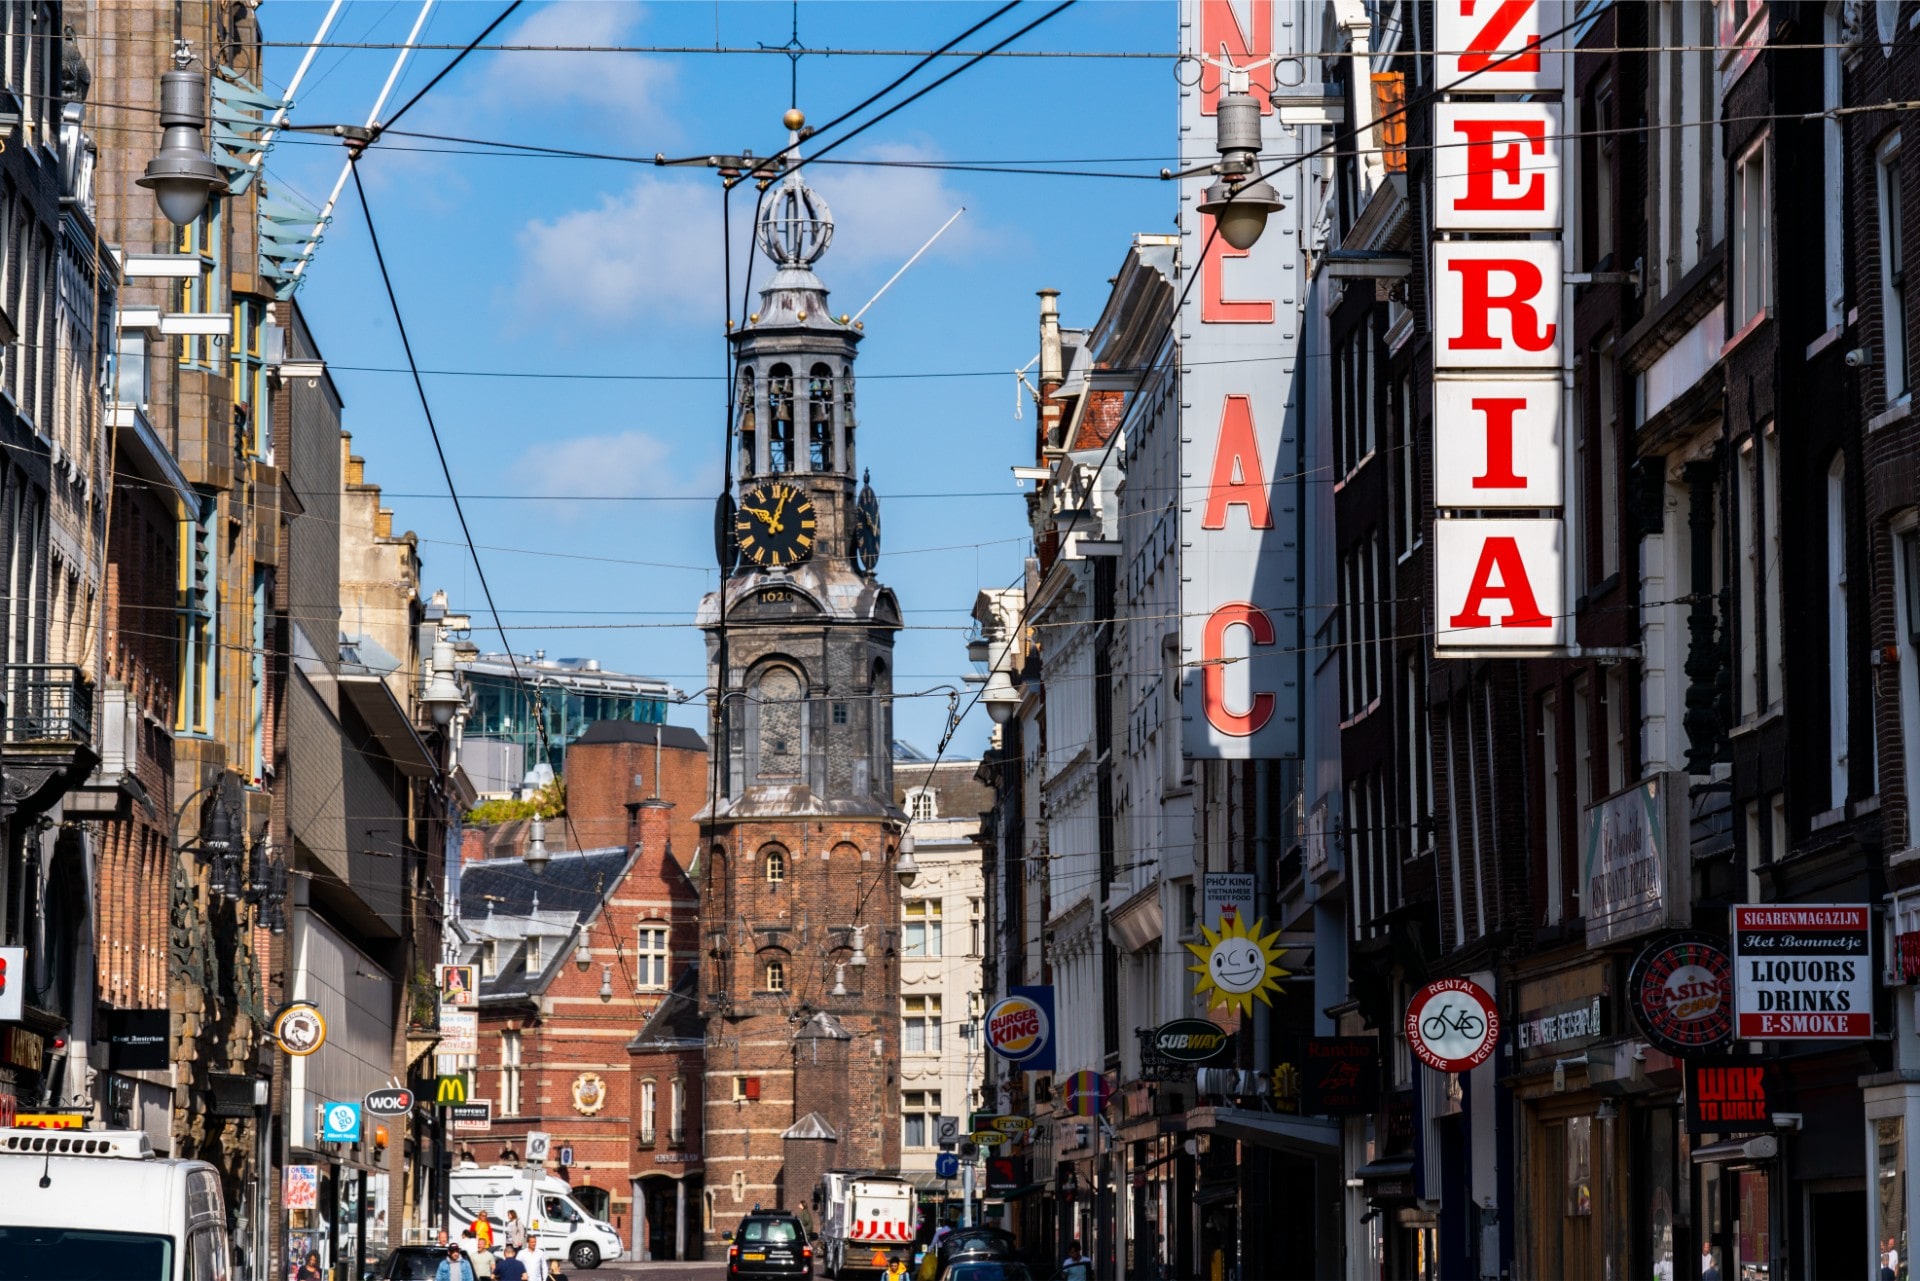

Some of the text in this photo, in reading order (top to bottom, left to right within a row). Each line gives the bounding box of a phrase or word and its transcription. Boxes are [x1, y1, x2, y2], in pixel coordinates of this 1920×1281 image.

[1229, 878, 1252, 886] KING
[1744, 911, 1860, 926] SIGARENMAGAZIJN
[1743, 934, 1862, 950] Het Bommetje
[1751, 961, 1856, 984] LIQUORS
[1428, 980, 1474, 994] RENTAL
[1757, 990, 1851, 1012] DRINKS
[990, 1008, 1037, 1032] BURGER
[1760, 1015, 1849, 1033] E-SMOKE
[992, 1019, 1039, 1047] KING
[1470, 1010, 1499, 1064] VERKOOP
[1156, 1034, 1226, 1050] SUBWAY
[1408, 1014, 1448, 1070] REPARATIE
[1697, 1067, 1765, 1100] WOK
[370, 1096, 405, 1109] WOK
[335, 1109, 347, 1120] to
[1699, 1101, 1766, 1121] TO WALK
[338, 1116, 352, 1130] go
[996, 1119, 1028, 1129] FLASH
[975, 1133, 1003, 1142] FLASH
